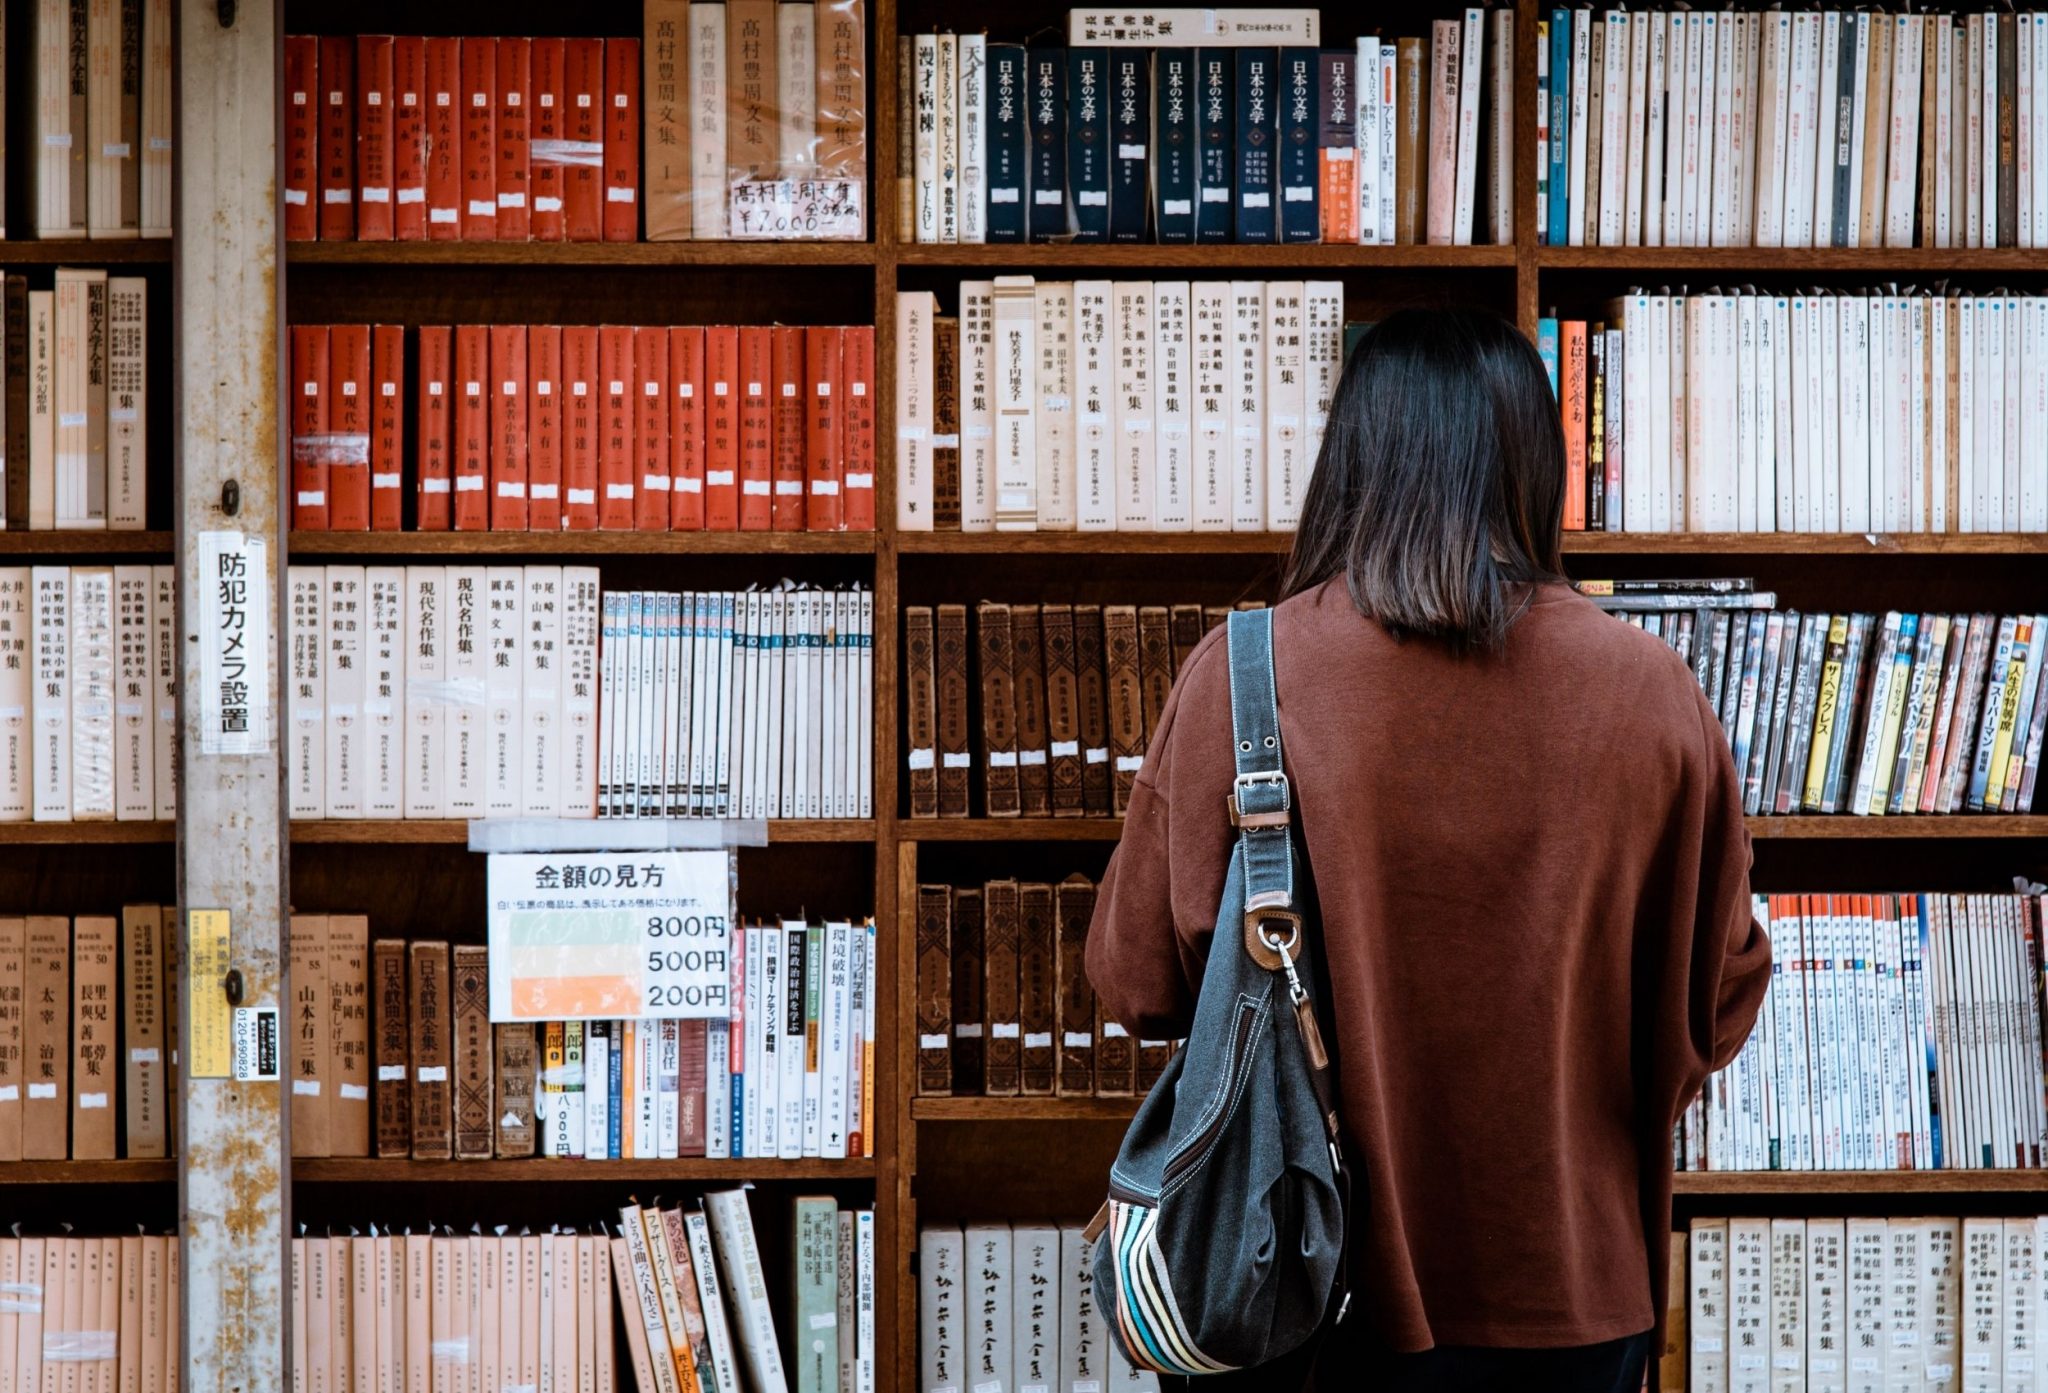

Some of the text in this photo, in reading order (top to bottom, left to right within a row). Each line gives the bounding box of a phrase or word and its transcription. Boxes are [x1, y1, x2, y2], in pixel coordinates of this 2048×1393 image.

[918, 46, 934, 134] 漫才病棟
[999, 60, 1014, 123] 日本の文学
[1039, 62, 1054, 125] 日本の文学
[1081, 59, 1097, 123] 日本の文学
[1120, 62, 1136, 125] 日本の文学
[1168, 61, 1183, 124] 日本の文学
[1208, 62, 1223, 123] 日本の文学
[1250, 62, 1265, 125] 日本の文学
[1292, 61, 1308, 123] 日本の文学
[1331, 61, 1346, 125] 日本の文学
[1382, 105, 1394, 154] アドラー
[922, 181, 931, 231] ビートたけし
[88, 284, 103, 386] 昭和文学全集
[119, 394, 134, 409] 集
[1127, 395, 1142, 411] 集
[1280, 370, 1295, 384] 集
[1204, 398, 1219, 413] 集
[539, 398, 551, 470] 山本有三
[575, 398, 587, 470] 石川達三
[13, 581, 24, 651] 井上靖
[346, 581, 357, 651] 宇野浩二
[419, 581, 435, 658] 現代名作集
[457, 577, 473, 654] 現代名作集
[6, 654, 21, 670] 集
[219, 552, 249, 734] 防犯カメラ設置
[338, 655, 352, 669] 集
[495, 652, 510, 668] 集
[535, 655, 550, 669] 集
[47, 682, 61, 698] 集
[127, 682, 142, 698] 集
[299, 684, 313, 698] 集
[574, 683, 588, 698] 集
[1816, 665, 1840, 736] ザ・ヘラクレス
[1981, 686, 2006, 748] スーパーマン
[1999, 664, 2022, 733] 人生の特等席
[535, 863, 666, 889] 金額の見方
[647, 916, 725, 938] 800円
[6, 962, 18, 972] 64
[96, 953, 107, 965] 50
[309, 959, 321, 970] 55
[350, 959, 361, 970] 91
[648, 951, 725, 973] 500円
[787, 934, 801, 1033] 国際政治経済を学ぶ
[831, 928, 846, 987] 環境破壊
[851, 933, 865, 1010] スポーツ科学概論
[648, 985, 726, 1007] 200円
[764, 956, 776, 1053] 損保マーケティング戦略
[87, 1061, 101, 1077] 集
[237, 1008, 248, 1079] 0120-690828
[1702, 1303, 1716, 1317] 集
[1741, 1332, 1755, 1347] 集
[1861, 1333, 1875, 1348] 集
